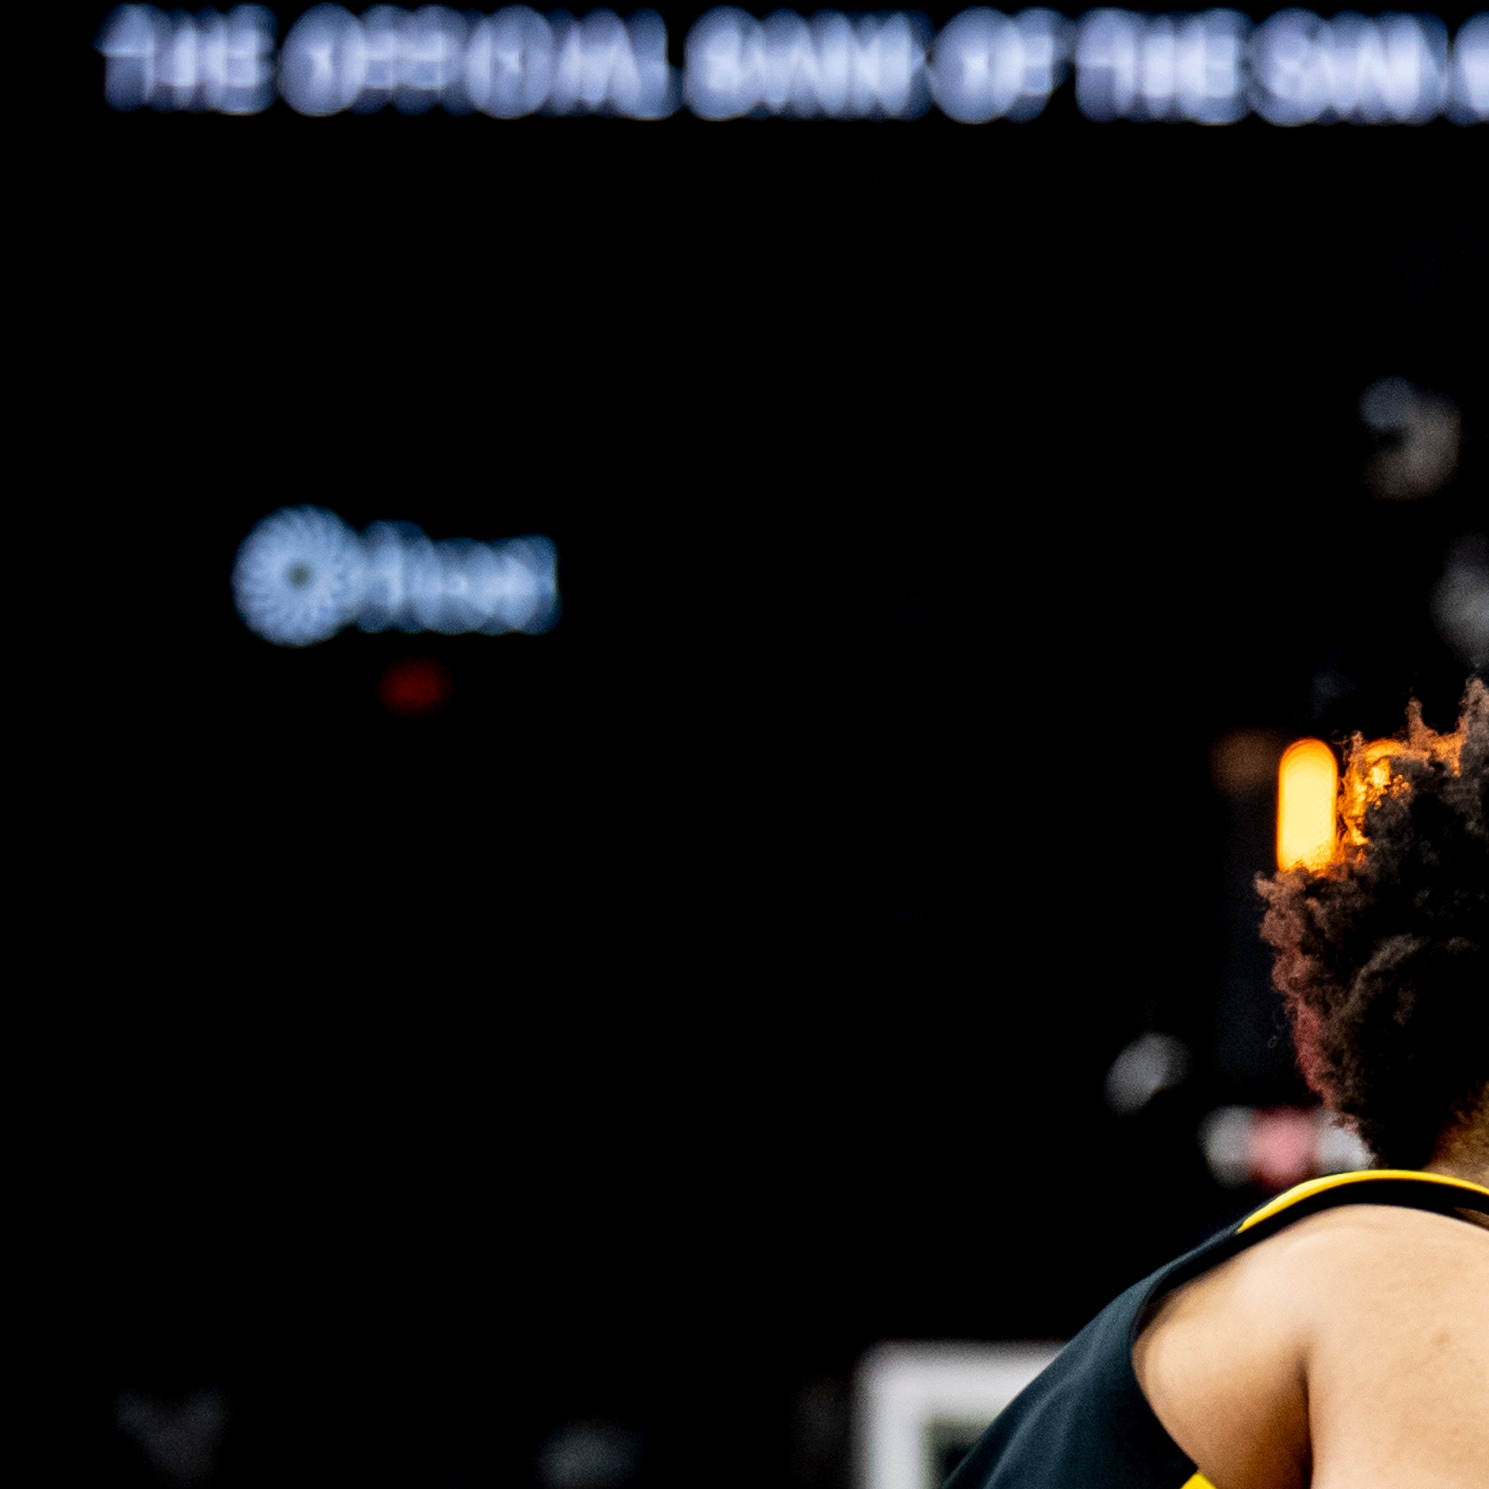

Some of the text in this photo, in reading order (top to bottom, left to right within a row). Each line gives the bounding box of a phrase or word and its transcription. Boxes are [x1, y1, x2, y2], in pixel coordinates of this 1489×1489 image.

[98, 3, 275, 114] THE
[278, 3, 680, 119] OFFICIAL
[683, 5, 930, 120] BANK
[927, 6, 1068, 124] OF
[1072, 6, 1247, 125] THE
[1243, 8, 1448, 126] SAN
